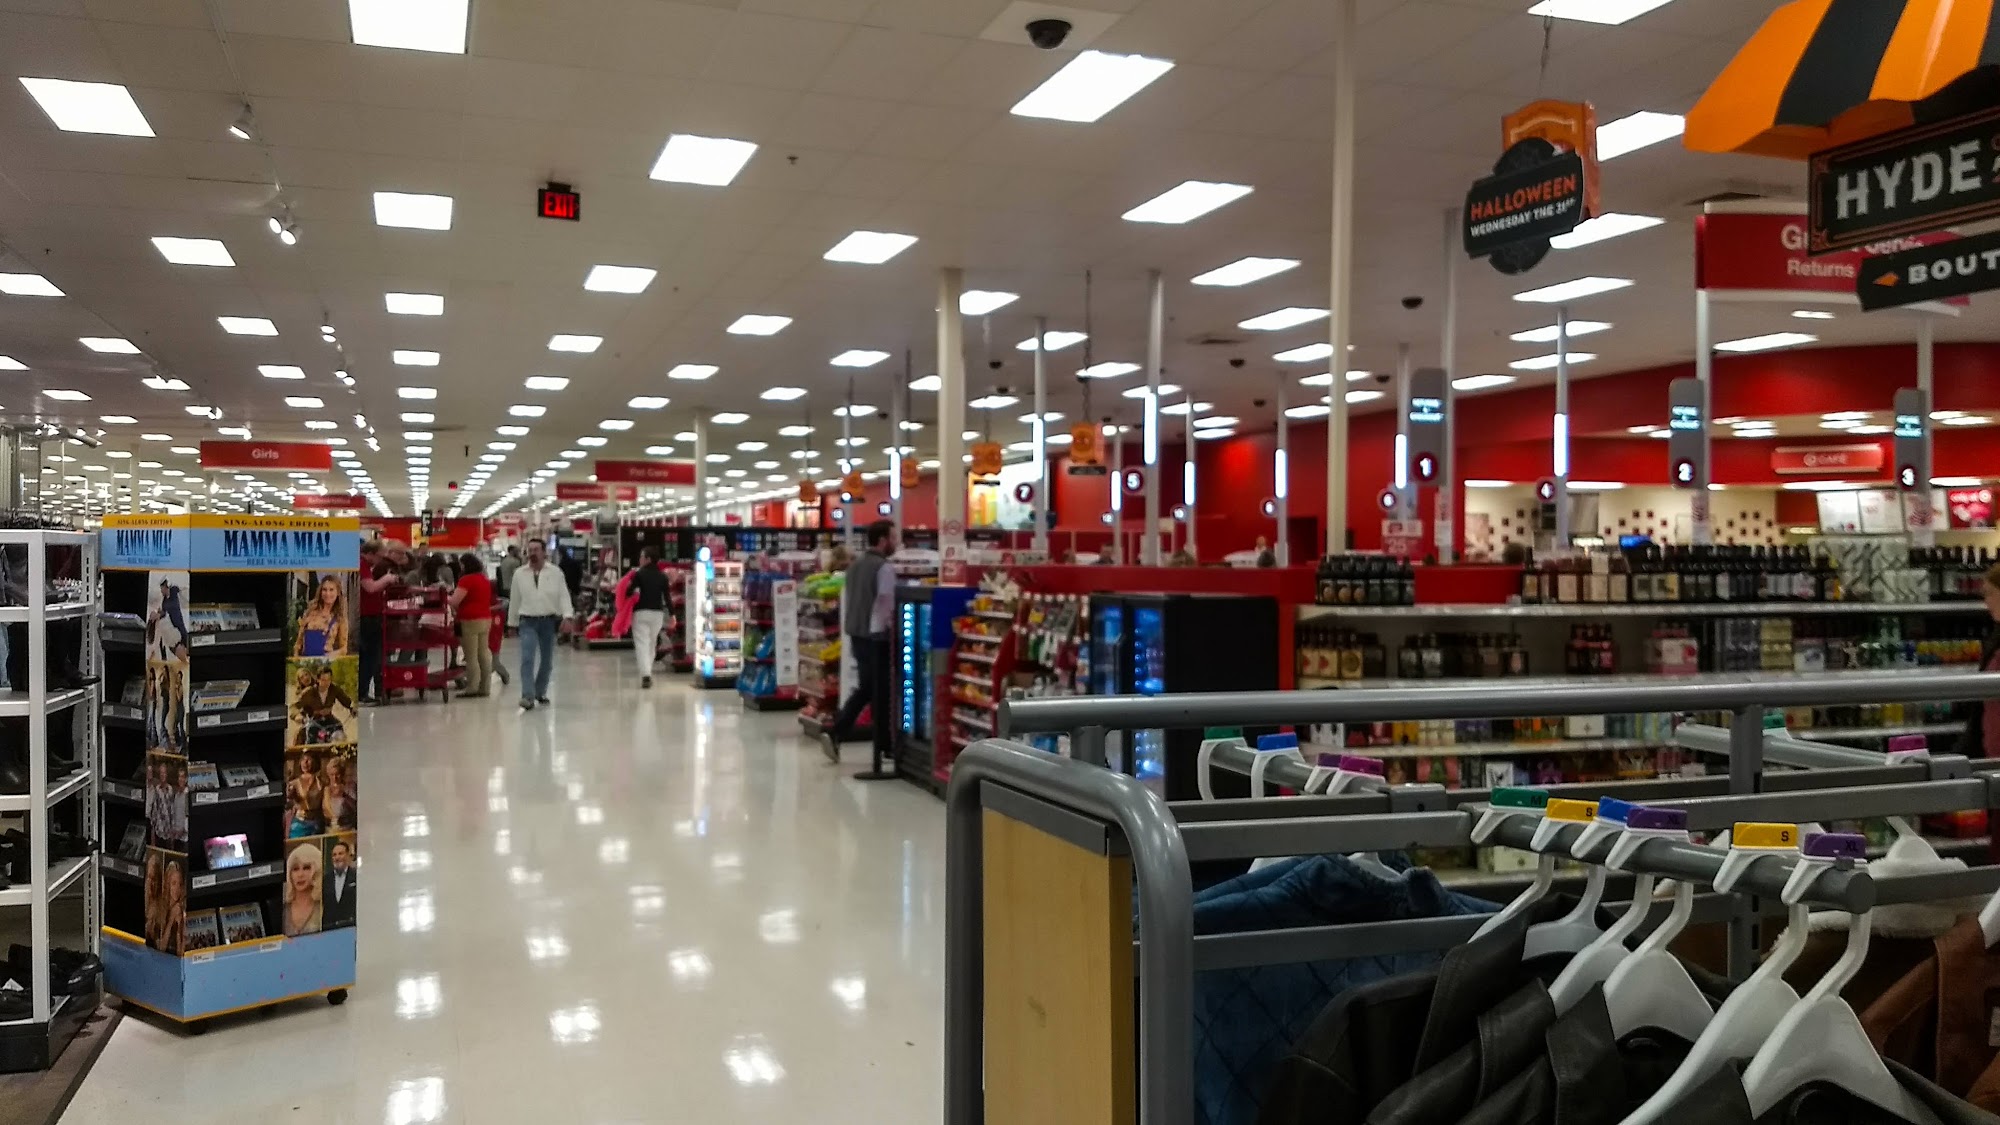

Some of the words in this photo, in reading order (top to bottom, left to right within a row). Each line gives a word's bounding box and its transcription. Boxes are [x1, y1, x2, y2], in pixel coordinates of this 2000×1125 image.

[1835, 138, 1982, 219] HYDE
[1470, 174, 1577, 222] HALLOWEEN
[1470, 211, 1531, 238] WEDNESDAY
[1533, 203, 1554, 220] THE
[1787, 259, 1855, 278] Returns
[1907, 247, 2000, 286] BOUT
[252, 448, 280, 460] Girls
[1419, 457, 1432, 477] 1
[1678, 462, 1693, 481] 2
[1902, 467, 1915, 486] 3
[1127, 472, 1140, 489] 5
[1019, 487, 1030, 502] 7
[224, 519, 285, 527] SING-ALONG
[289, 520, 330, 528] EDITION
[116, 529, 150, 556] MAMMA
[152, 529, 173, 557] MIA!
[224, 529, 290, 557] MAMMA
[293, 530, 331, 558] MIA!
[1585, 806, 1593, 818] S
[1780, 830, 1790, 842] S
[1845, 840, 1857, 852] XL
